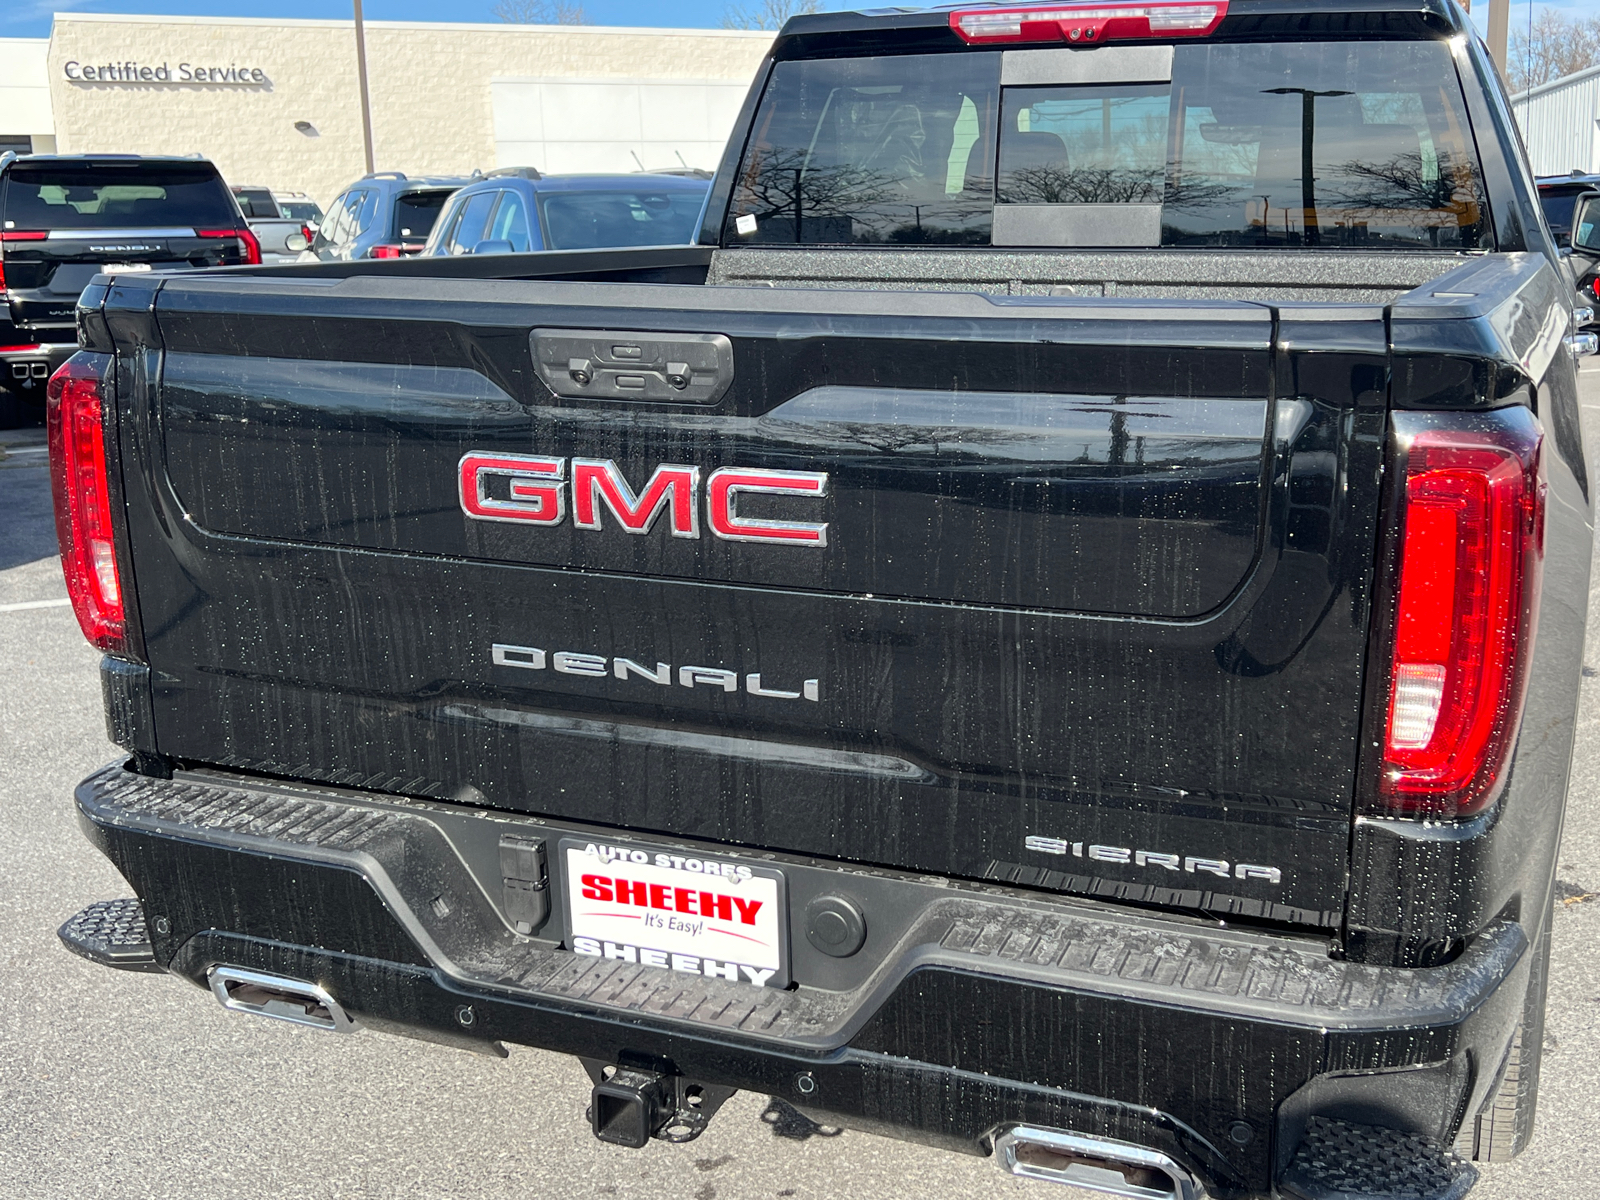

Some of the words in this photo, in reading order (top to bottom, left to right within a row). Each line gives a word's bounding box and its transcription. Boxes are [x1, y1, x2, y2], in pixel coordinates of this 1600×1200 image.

[64, 61, 169, 80] Certified
[179, 63, 264, 82] Service
[457, 450, 829, 548] GMC
[491, 643, 819, 702] DENALI
[584, 843, 649, 864] AUTO
[654, 854, 753, 880] STORES
[1025, 835, 1282, 884] SIERRA
[581, 873, 764, 926] SHEEHY
[644, 912, 664, 930] It's
[668, 916, 704, 937] Easy!
[573, 937, 776, 987] SHEEHY
